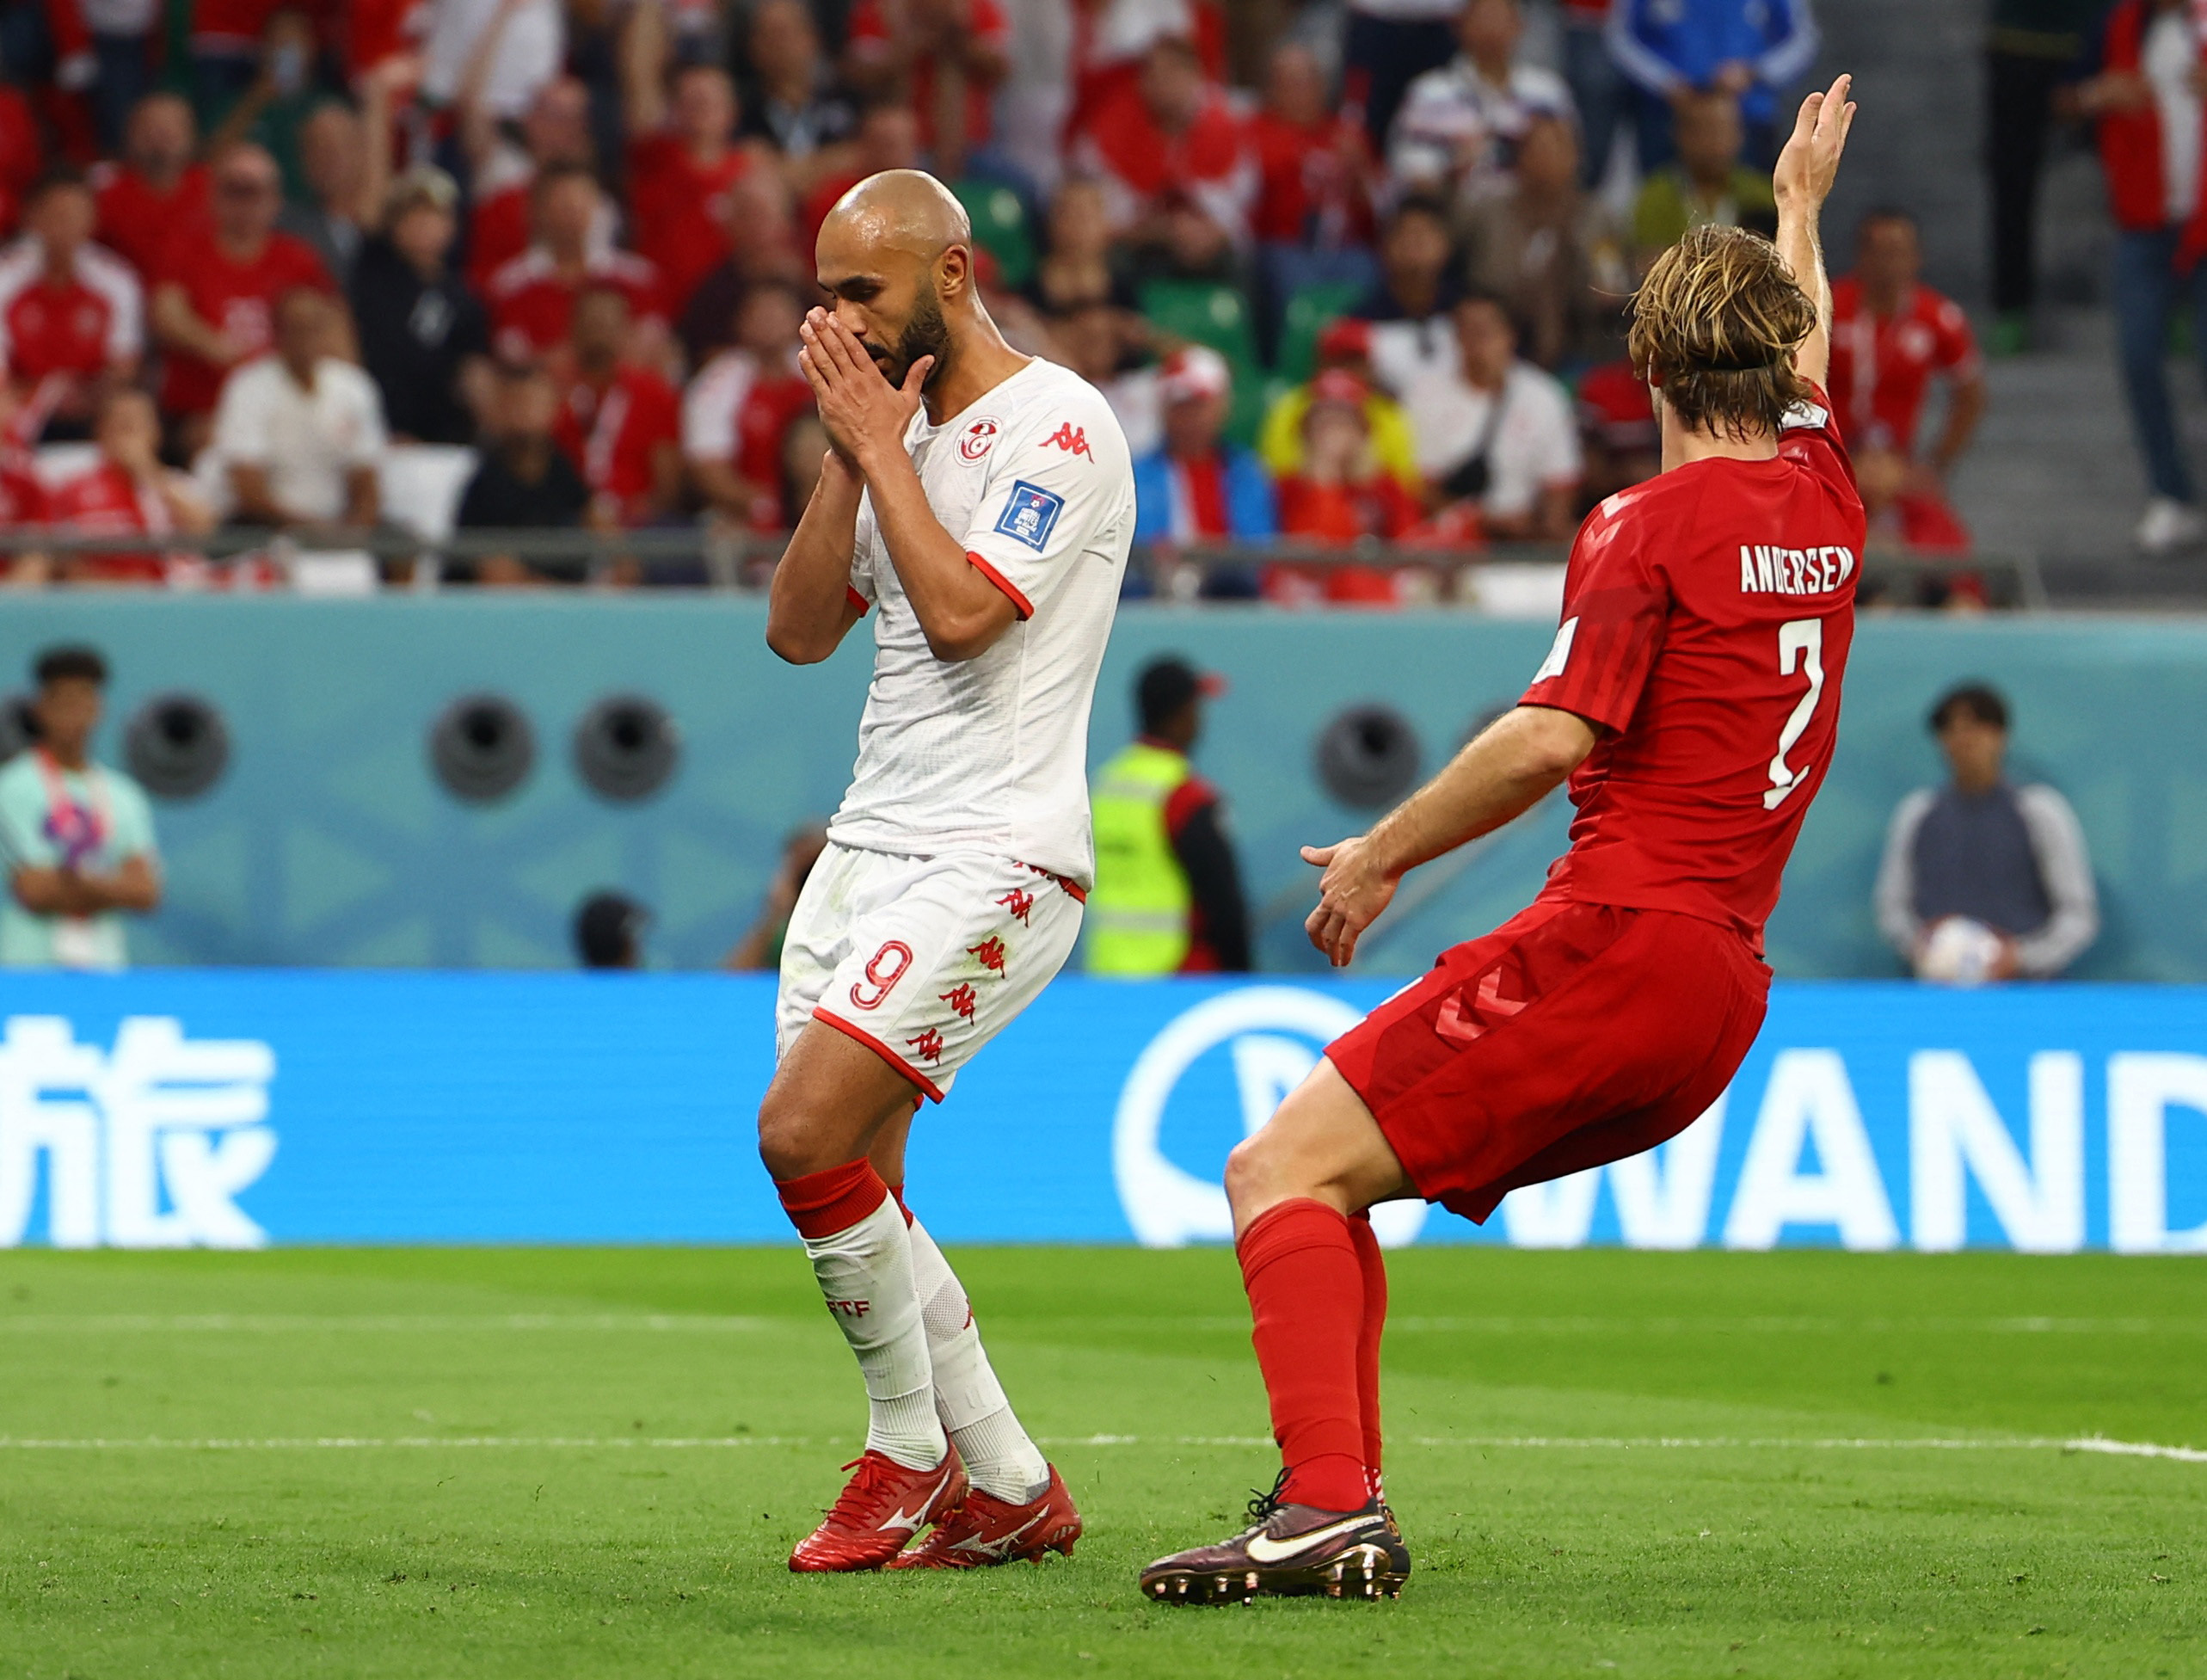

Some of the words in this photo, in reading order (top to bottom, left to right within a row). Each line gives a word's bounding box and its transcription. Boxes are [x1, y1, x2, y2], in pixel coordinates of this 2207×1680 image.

[1739, 545, 1855, 595] ANDERSEN
[1762, 618, 1825, 810] 2
[849, 939, 913, 1011] 9
